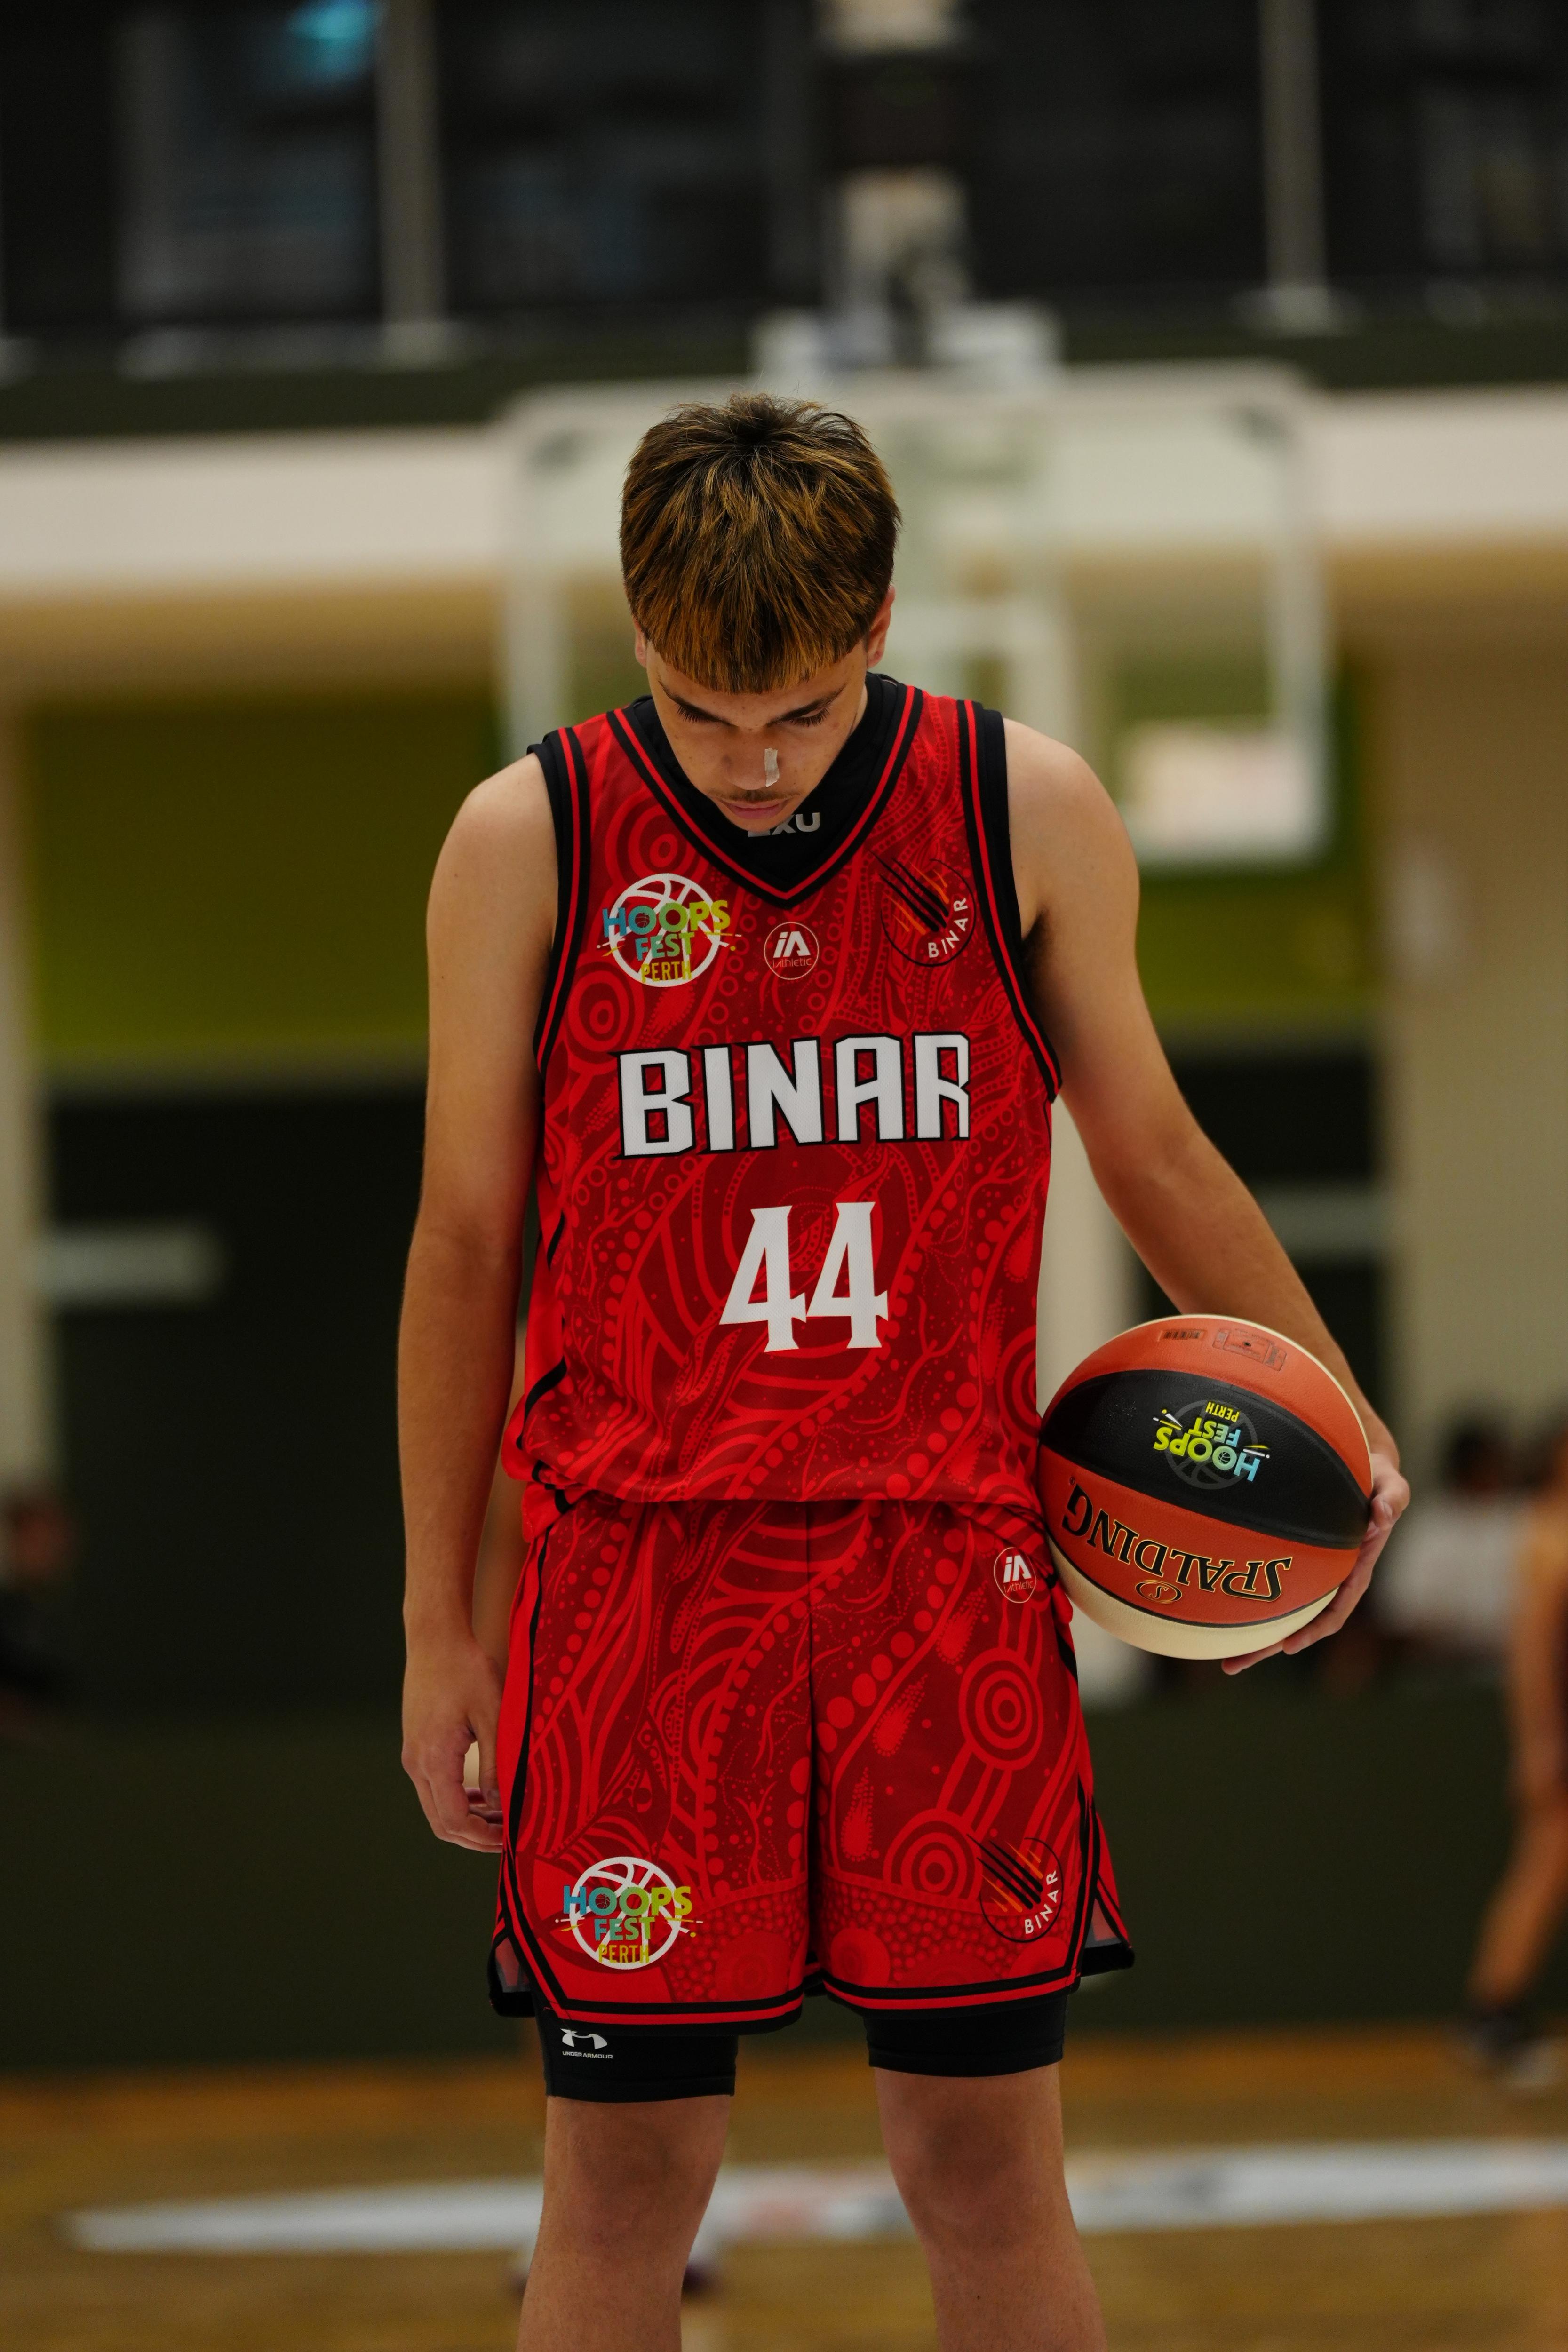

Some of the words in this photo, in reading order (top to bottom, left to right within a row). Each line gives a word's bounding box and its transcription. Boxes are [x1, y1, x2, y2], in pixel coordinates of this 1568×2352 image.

[748, 812, 820, 838] XU
[602, 900, 730, 937] HOOPS
[928, 898, 968, 958] BINAR
[635, 932, 694, 961] FEST
[641, 960, 692, 983] PERTH
[613, 1032, 971, 1159] BINAR
[719, 1202, 888, 1352] 44
[1205, 1402, 1240, 1422] PERTH
[1188, 1417, 1241, 1447] FEST
[1153, 1427, 1260, 1482] HOOPS
[1062, 1483, 1293, 1603] SPALDING
[563, 1885, 692, 1916] HOOPS
[1025, 1870, 1059, 1934] BINAR
[594, 1916, 655, 1941] FEST
[598, 1943, 649, 1963] PERTH
